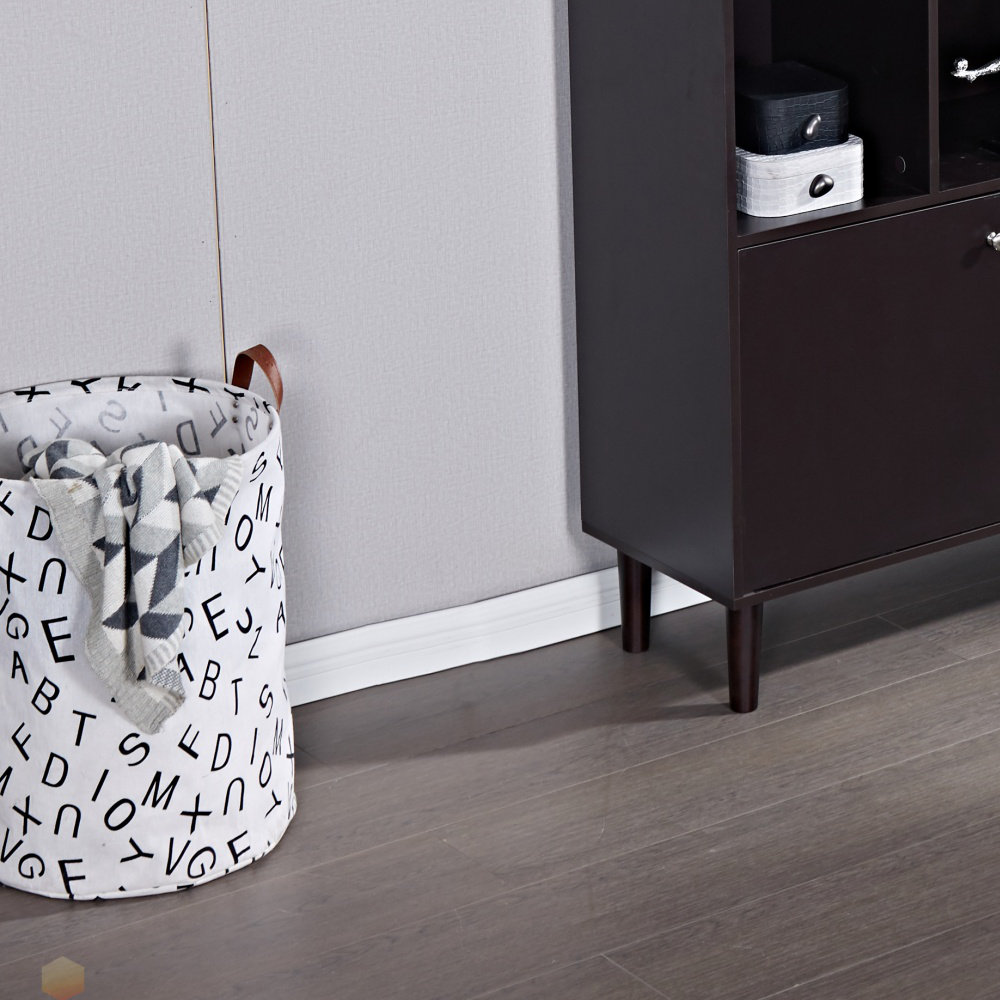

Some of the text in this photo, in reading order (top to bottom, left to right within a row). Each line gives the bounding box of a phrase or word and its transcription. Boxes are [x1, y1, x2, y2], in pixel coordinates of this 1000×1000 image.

[250, 451, 270, 483] S
[255, 482, 273, 522] M
[235, 515, 253, 551] O
[245, 555, 266, 583] Y
[6, 613, 29, 639] G
[202, 592, 228, 641] E
[236, 608, 252, 634] J
[277, 601, 285, 633] A
[41, 616, 75, 663] E
[11, 651, 28, 684] A
[199, 660, 220, 700] B
[31, 676, 60, 715] B
[232, 678, 242, 715] T
[259, 684, 274, 718] S
[11, 722, 31, 761] F
[73, 710, 96, 746] T
[178, 724, 199, 759] F
[272, 717, 284, 755] M
[119, 733, 150, 766] S
[211, 733, 231, 771] D
[42, 752, 68, 787] D
[259, 752, 271, 788] O
[141, 771, 180, 810] M
[266, 791, 281, 816] Y
[12, 795, 42, 836] X
[104, 798, 136, 831] O
[180, 793, 212, 834] X
[18, 853, 45, 879] G
[120, 838, 154, 863] Y
[166, 838, 191, 875] V
[188, 847, 216, 878] G
